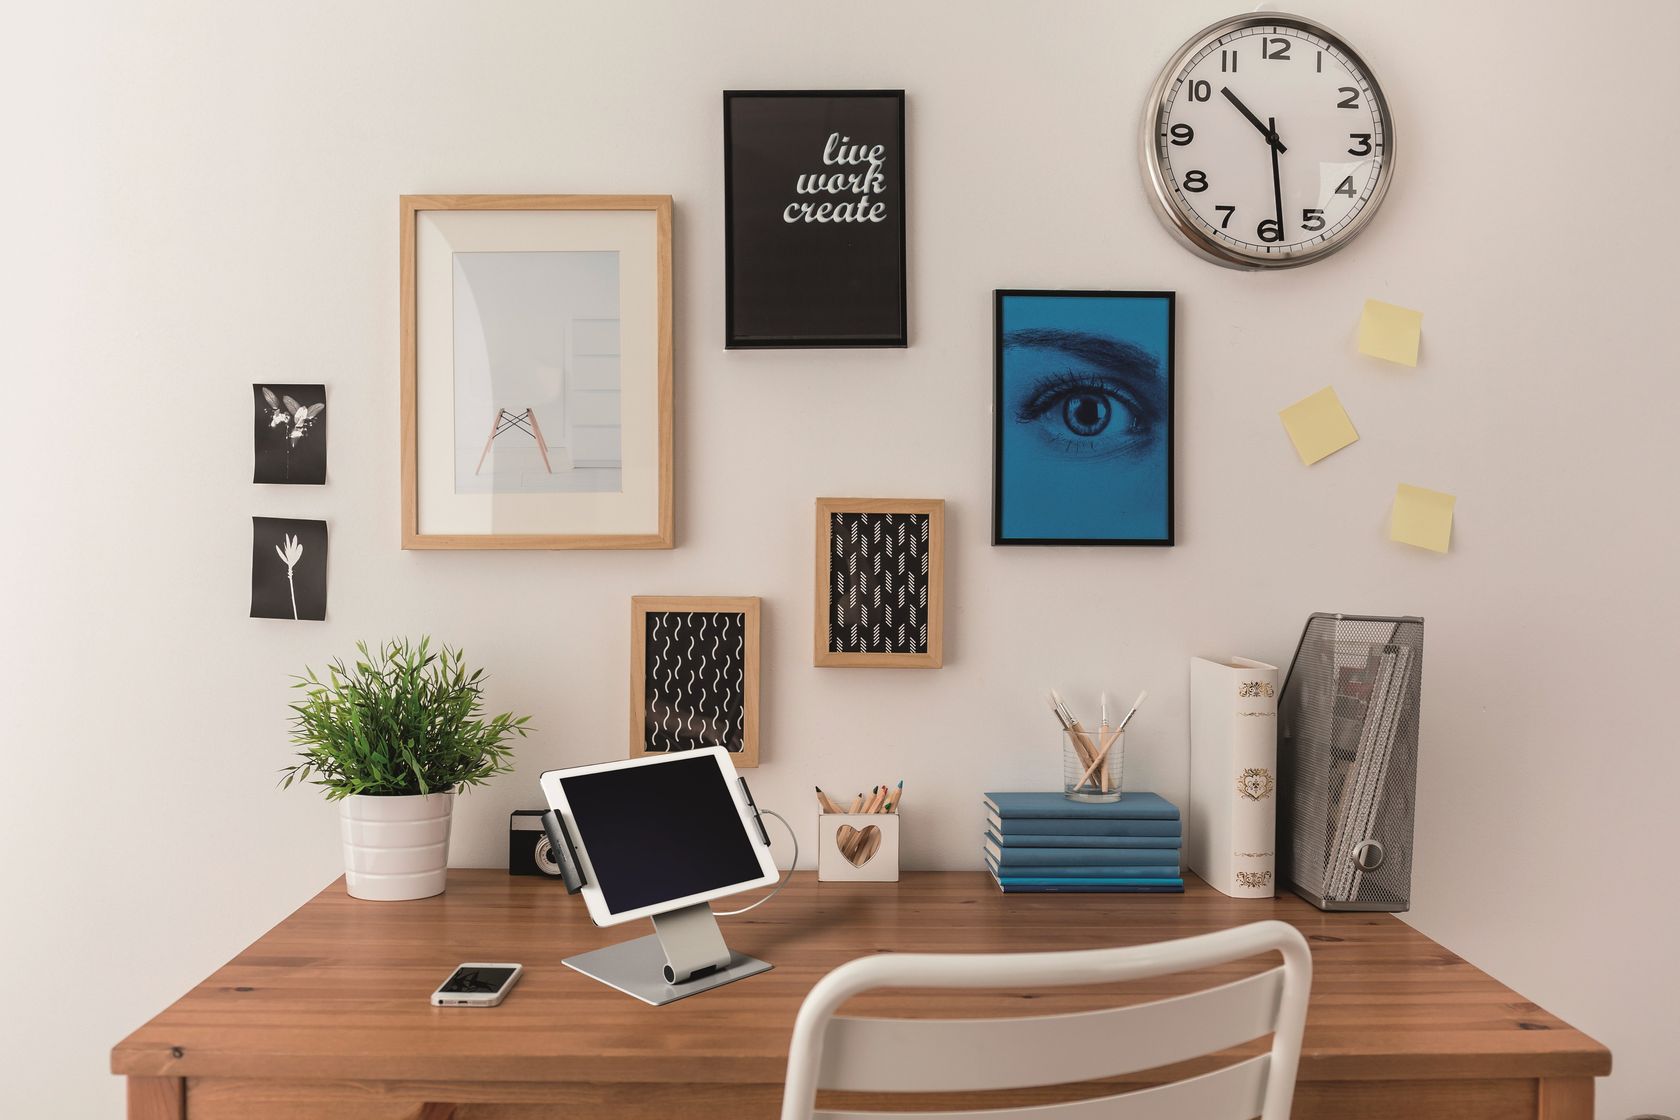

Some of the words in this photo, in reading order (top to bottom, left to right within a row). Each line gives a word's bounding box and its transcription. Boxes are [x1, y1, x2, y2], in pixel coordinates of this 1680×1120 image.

[1262, 37, 1291, 60] 12
[1221, 50, 1237, 72] 11
[1316, 51, 1322, 73] 1
[1188, 79, 1211, 102] 10
[1337, 86, 1360, 109] 2
[1170, 123, 1194, 146] 9
[1348, 133, 1372, 156] 3
[823, 132, 886, 166] live
[796, 162, 887, 195] work
[1183, 170, 1209, 192] 8
[1335, 175, 1357, 198] 4
[783, 195, 887, 223] create
[1215, 205, 1235, 228] 7
[1301, 208, 1326, 231] 5
[1256, 219, 1280, 243] 6
